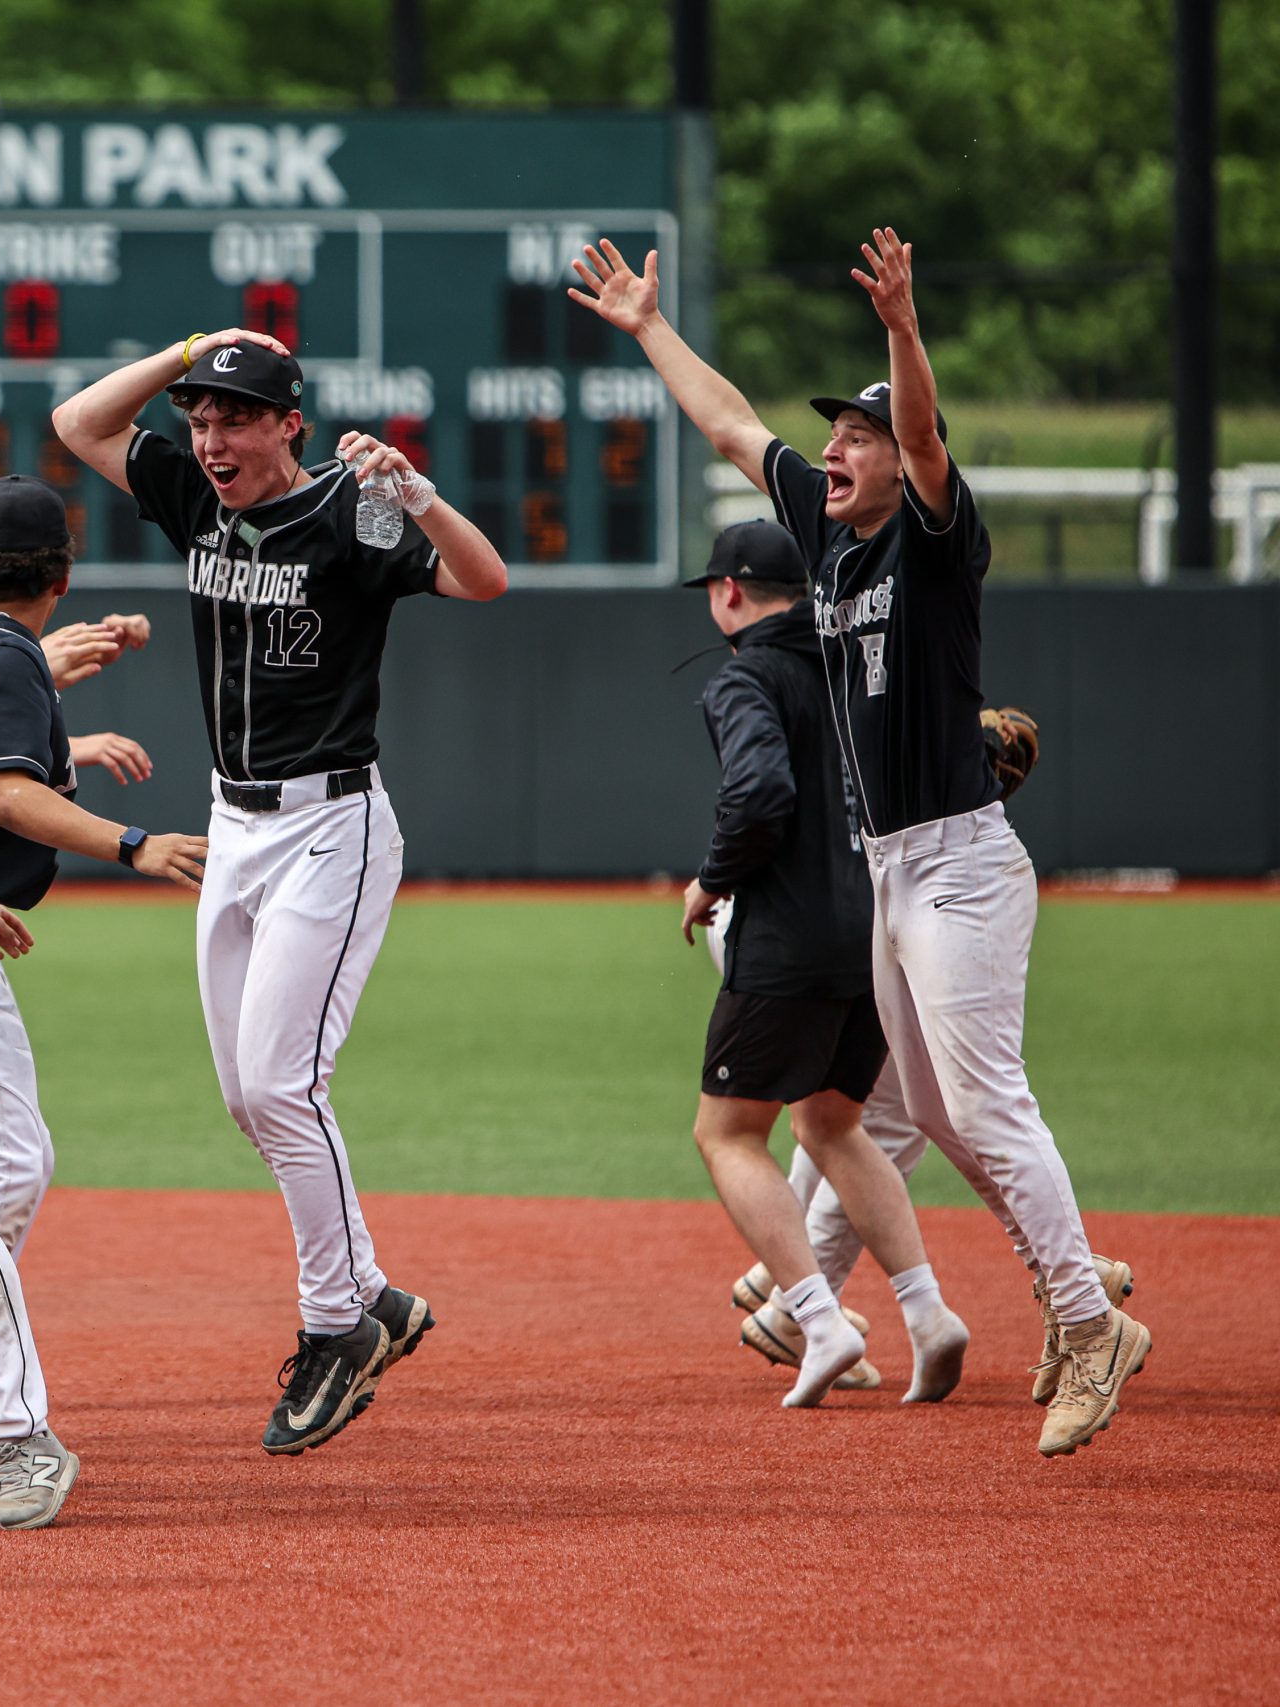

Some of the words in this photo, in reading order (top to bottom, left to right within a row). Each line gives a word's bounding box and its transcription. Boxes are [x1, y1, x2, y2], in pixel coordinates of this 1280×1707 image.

[82, 123, 346, 205] PARK
[211, 221, 324, 286] OUT
[4, 279, 61, 358] 0
[467, 366, 566, 420] HITS
[265, 608, 321, 667] 12
[858, 633, 887, 697] 8
